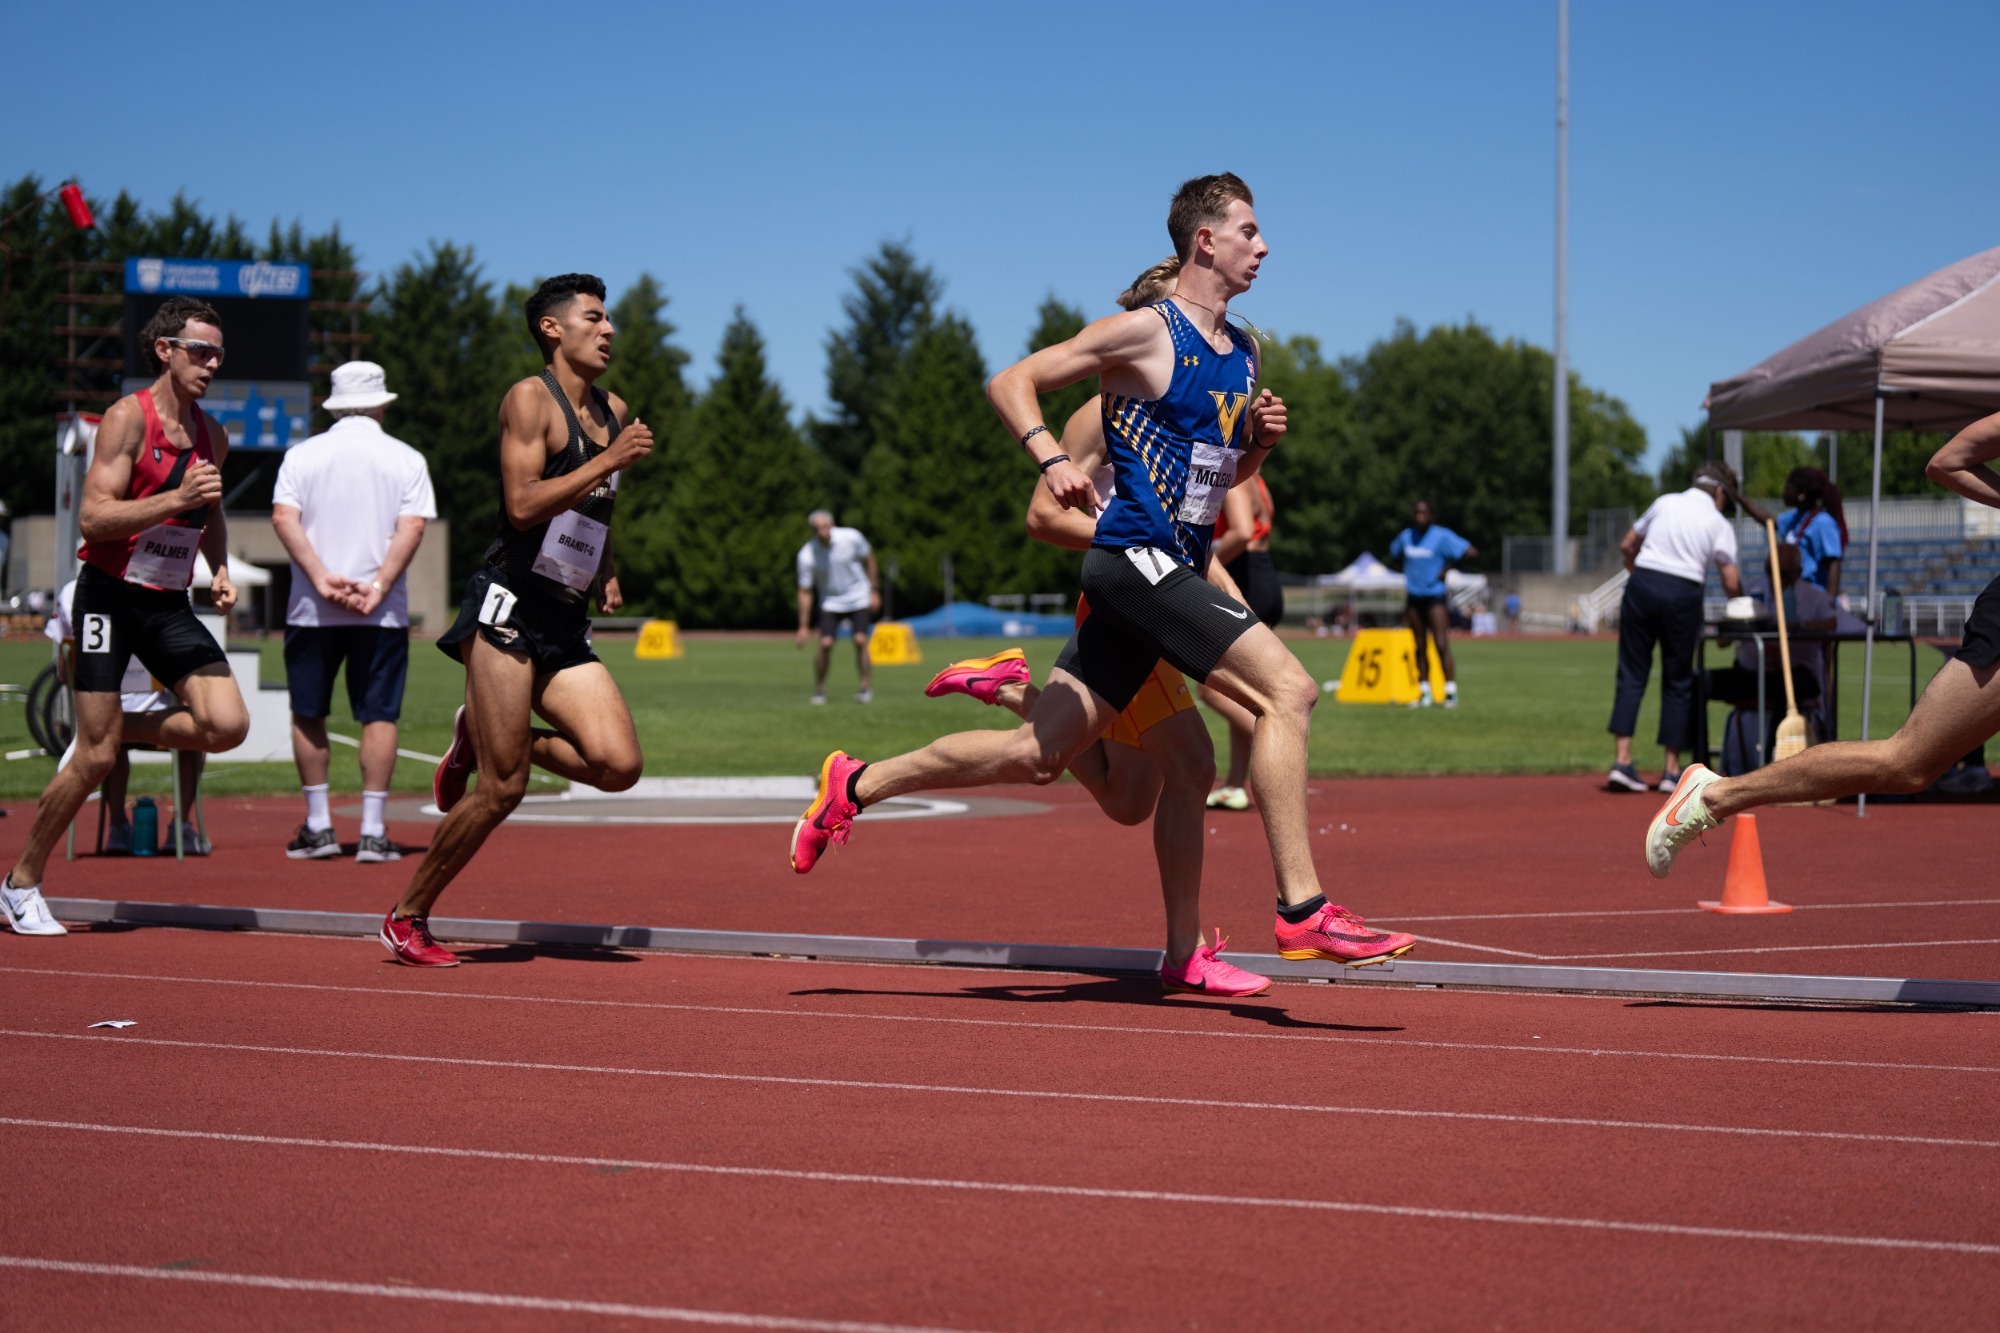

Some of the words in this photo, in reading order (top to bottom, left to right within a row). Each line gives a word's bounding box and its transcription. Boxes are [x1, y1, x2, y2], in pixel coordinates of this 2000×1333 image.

[144, 540, 189, 560] PALMER
[558, 533, 595, 557] BRANDT-G
[88, 616, 104, 650] 3
[1356, 648, 1384, 689] 15
